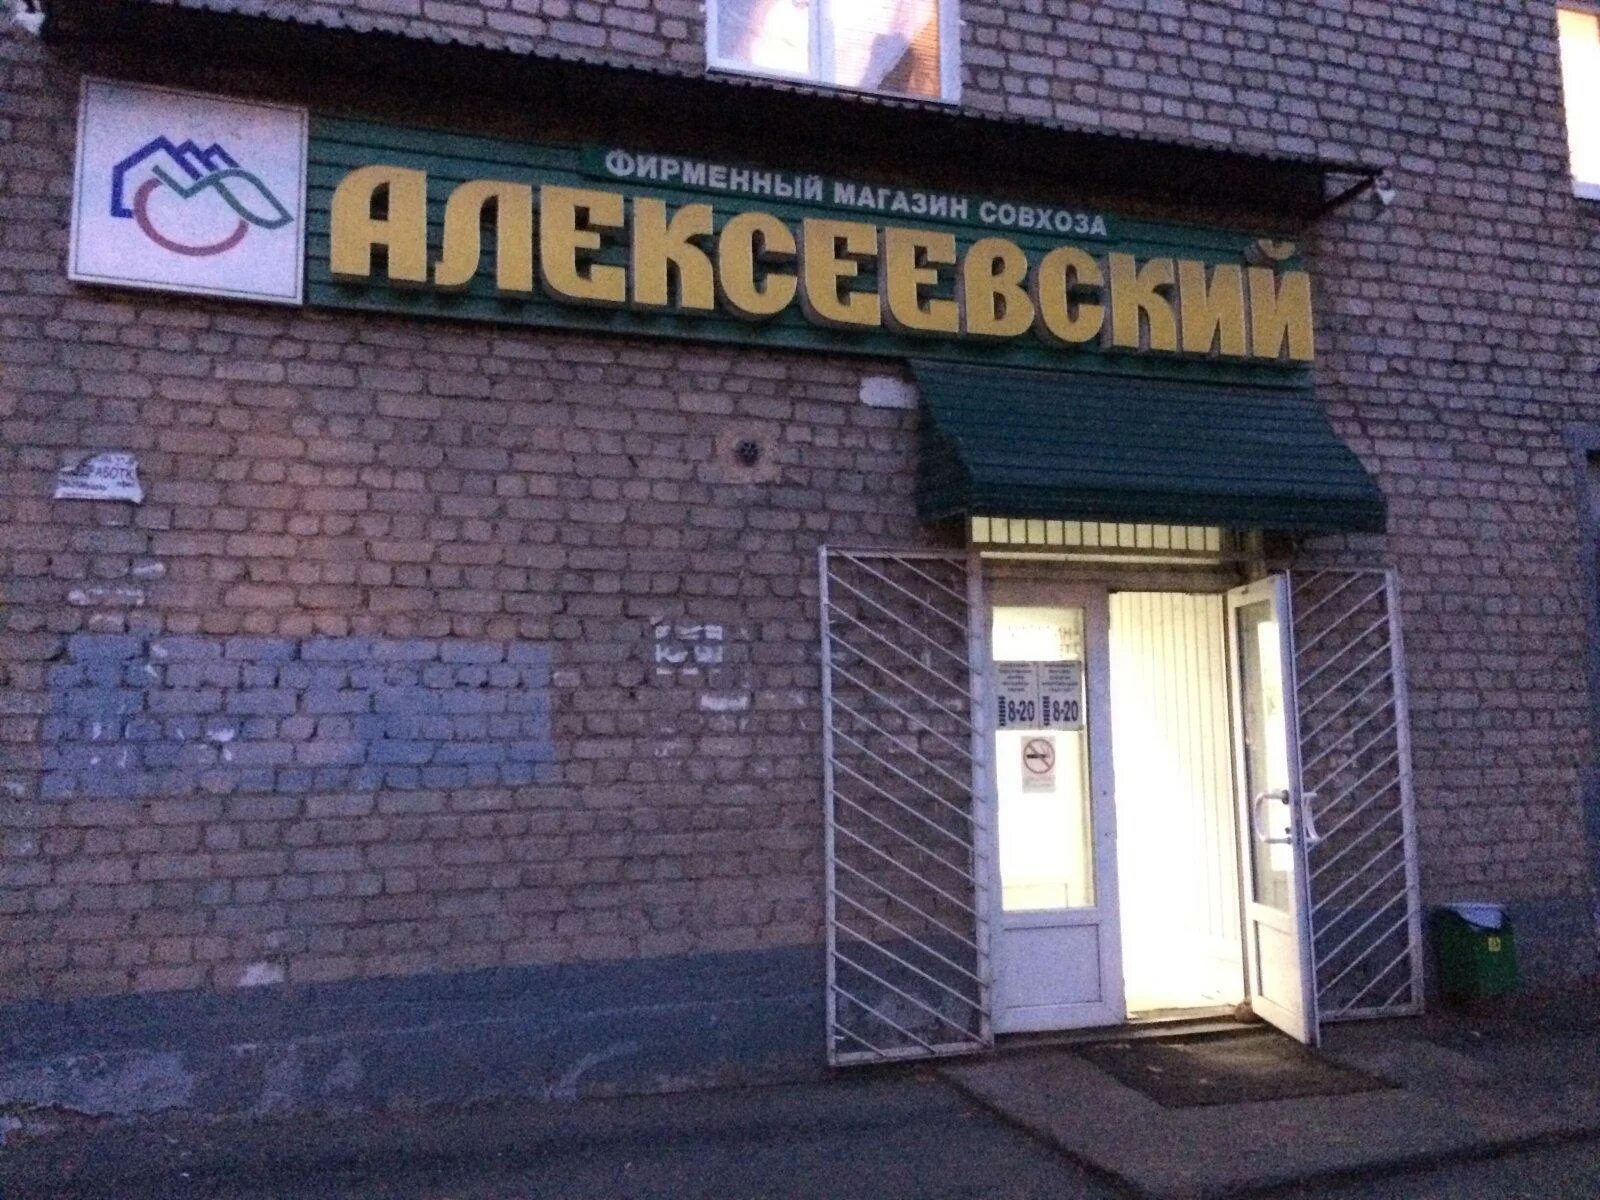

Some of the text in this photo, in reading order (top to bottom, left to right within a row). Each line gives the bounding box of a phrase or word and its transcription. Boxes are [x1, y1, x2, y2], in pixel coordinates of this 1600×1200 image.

[330, 164, 1315, 361] АЛЕКСЕЕВСКИЙ
[605, 149, 1107, 236] ФИРМЕННЫЙ МАГАЗИН СОВХОЗА
